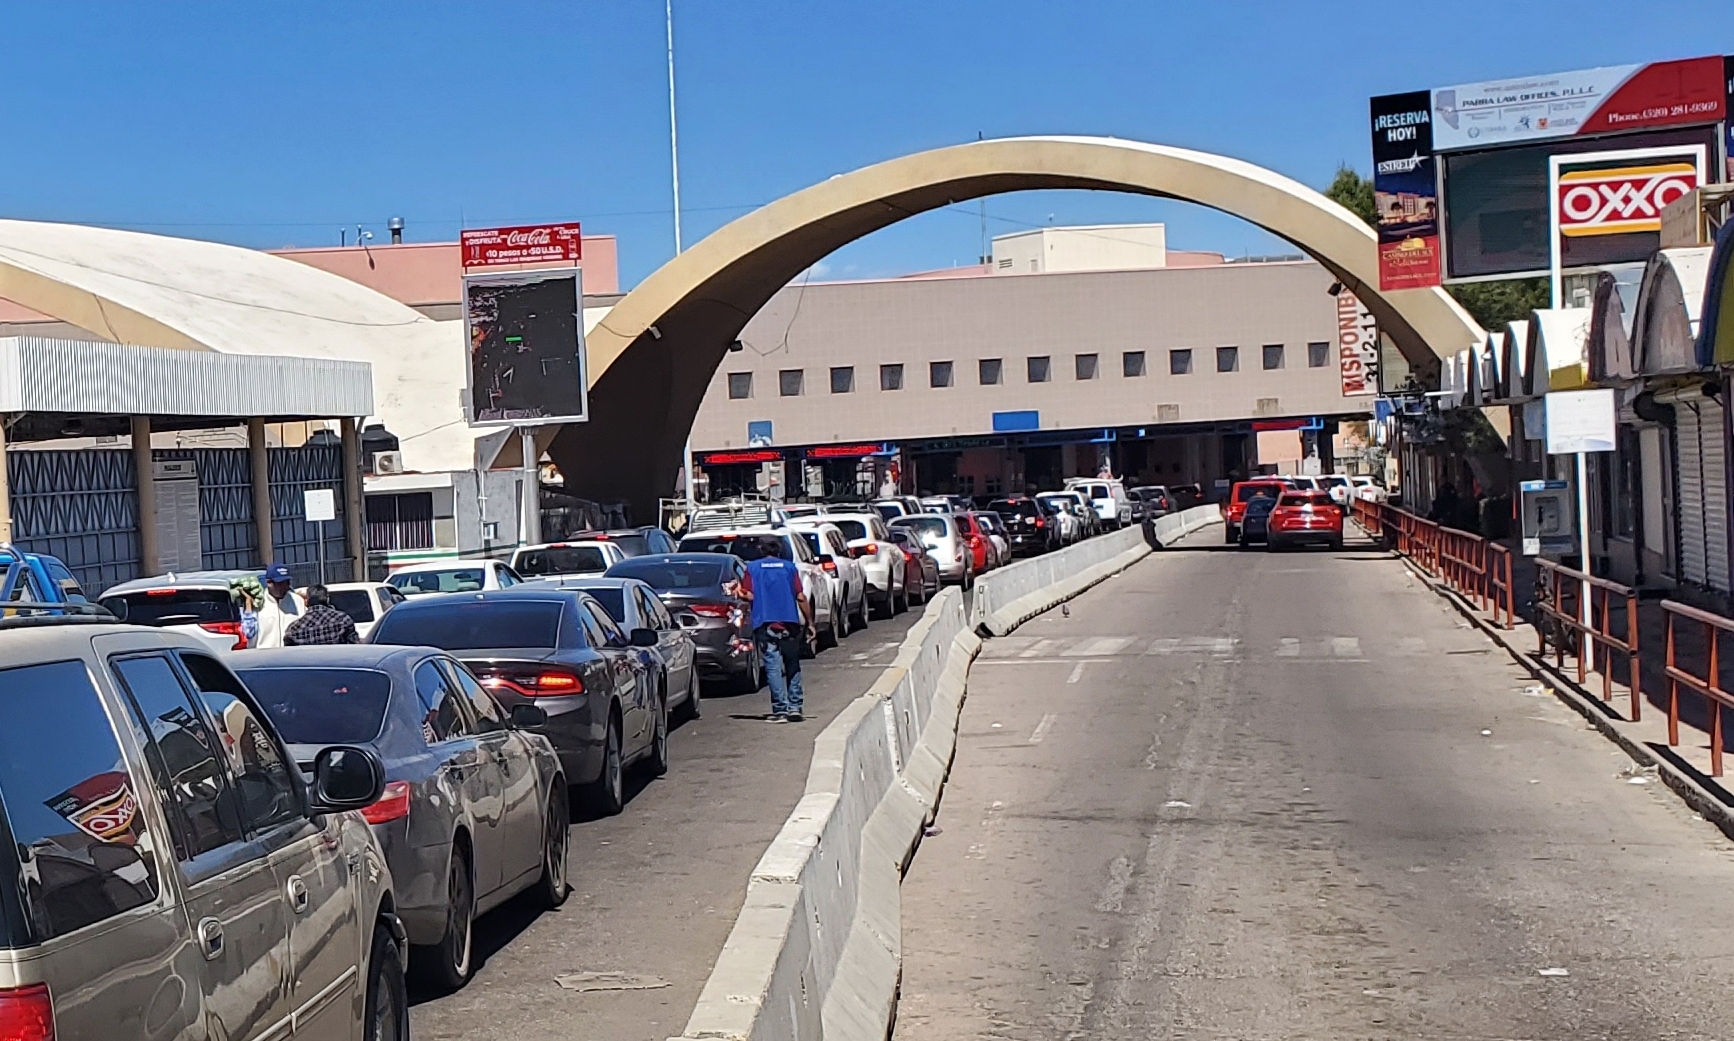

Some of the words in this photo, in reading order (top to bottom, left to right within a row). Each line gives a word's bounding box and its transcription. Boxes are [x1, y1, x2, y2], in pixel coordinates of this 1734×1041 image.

[1462, 97, 1495, 107] PARRA
[1497, 95, 1517, 104] LAW
[1374, 110, 1430, 132] ¡RESERVA
[1387, 126, 1417, 142] HOY!
[1563, 177, 1691, 223] OXXO
